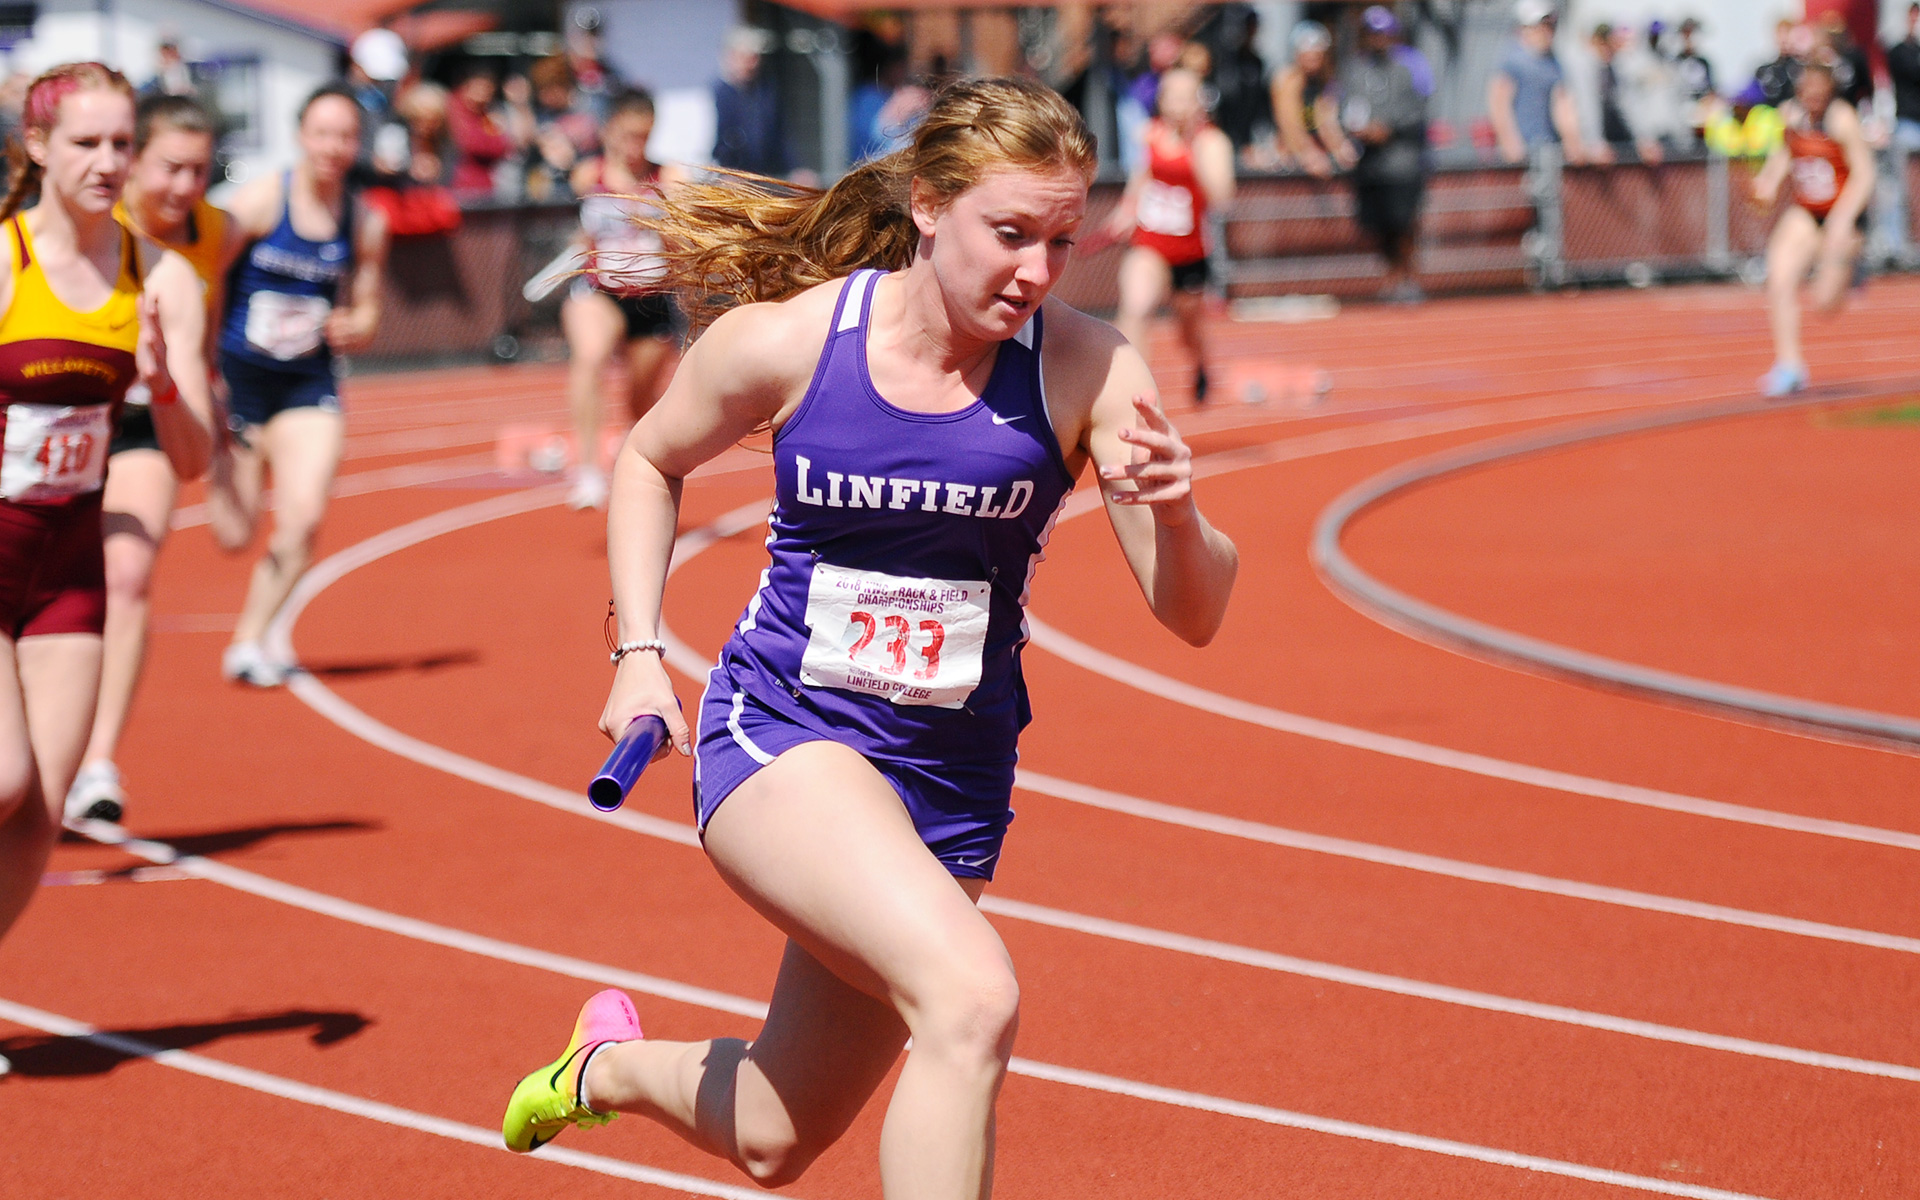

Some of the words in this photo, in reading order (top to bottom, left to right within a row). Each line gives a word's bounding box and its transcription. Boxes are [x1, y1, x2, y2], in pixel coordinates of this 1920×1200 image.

[795, 454, 1034, 519] LINFIELD
[857, 593, 945, 614] CHAMPIONSHIPS
[930, 589, 937, 601] &
[940, 589, 969, 602] FIELD
[848, 610, 946, 681] 233
[846, 674, 891, 692] LINFIELD
[892, 680, 932, 700] COLLEGE
